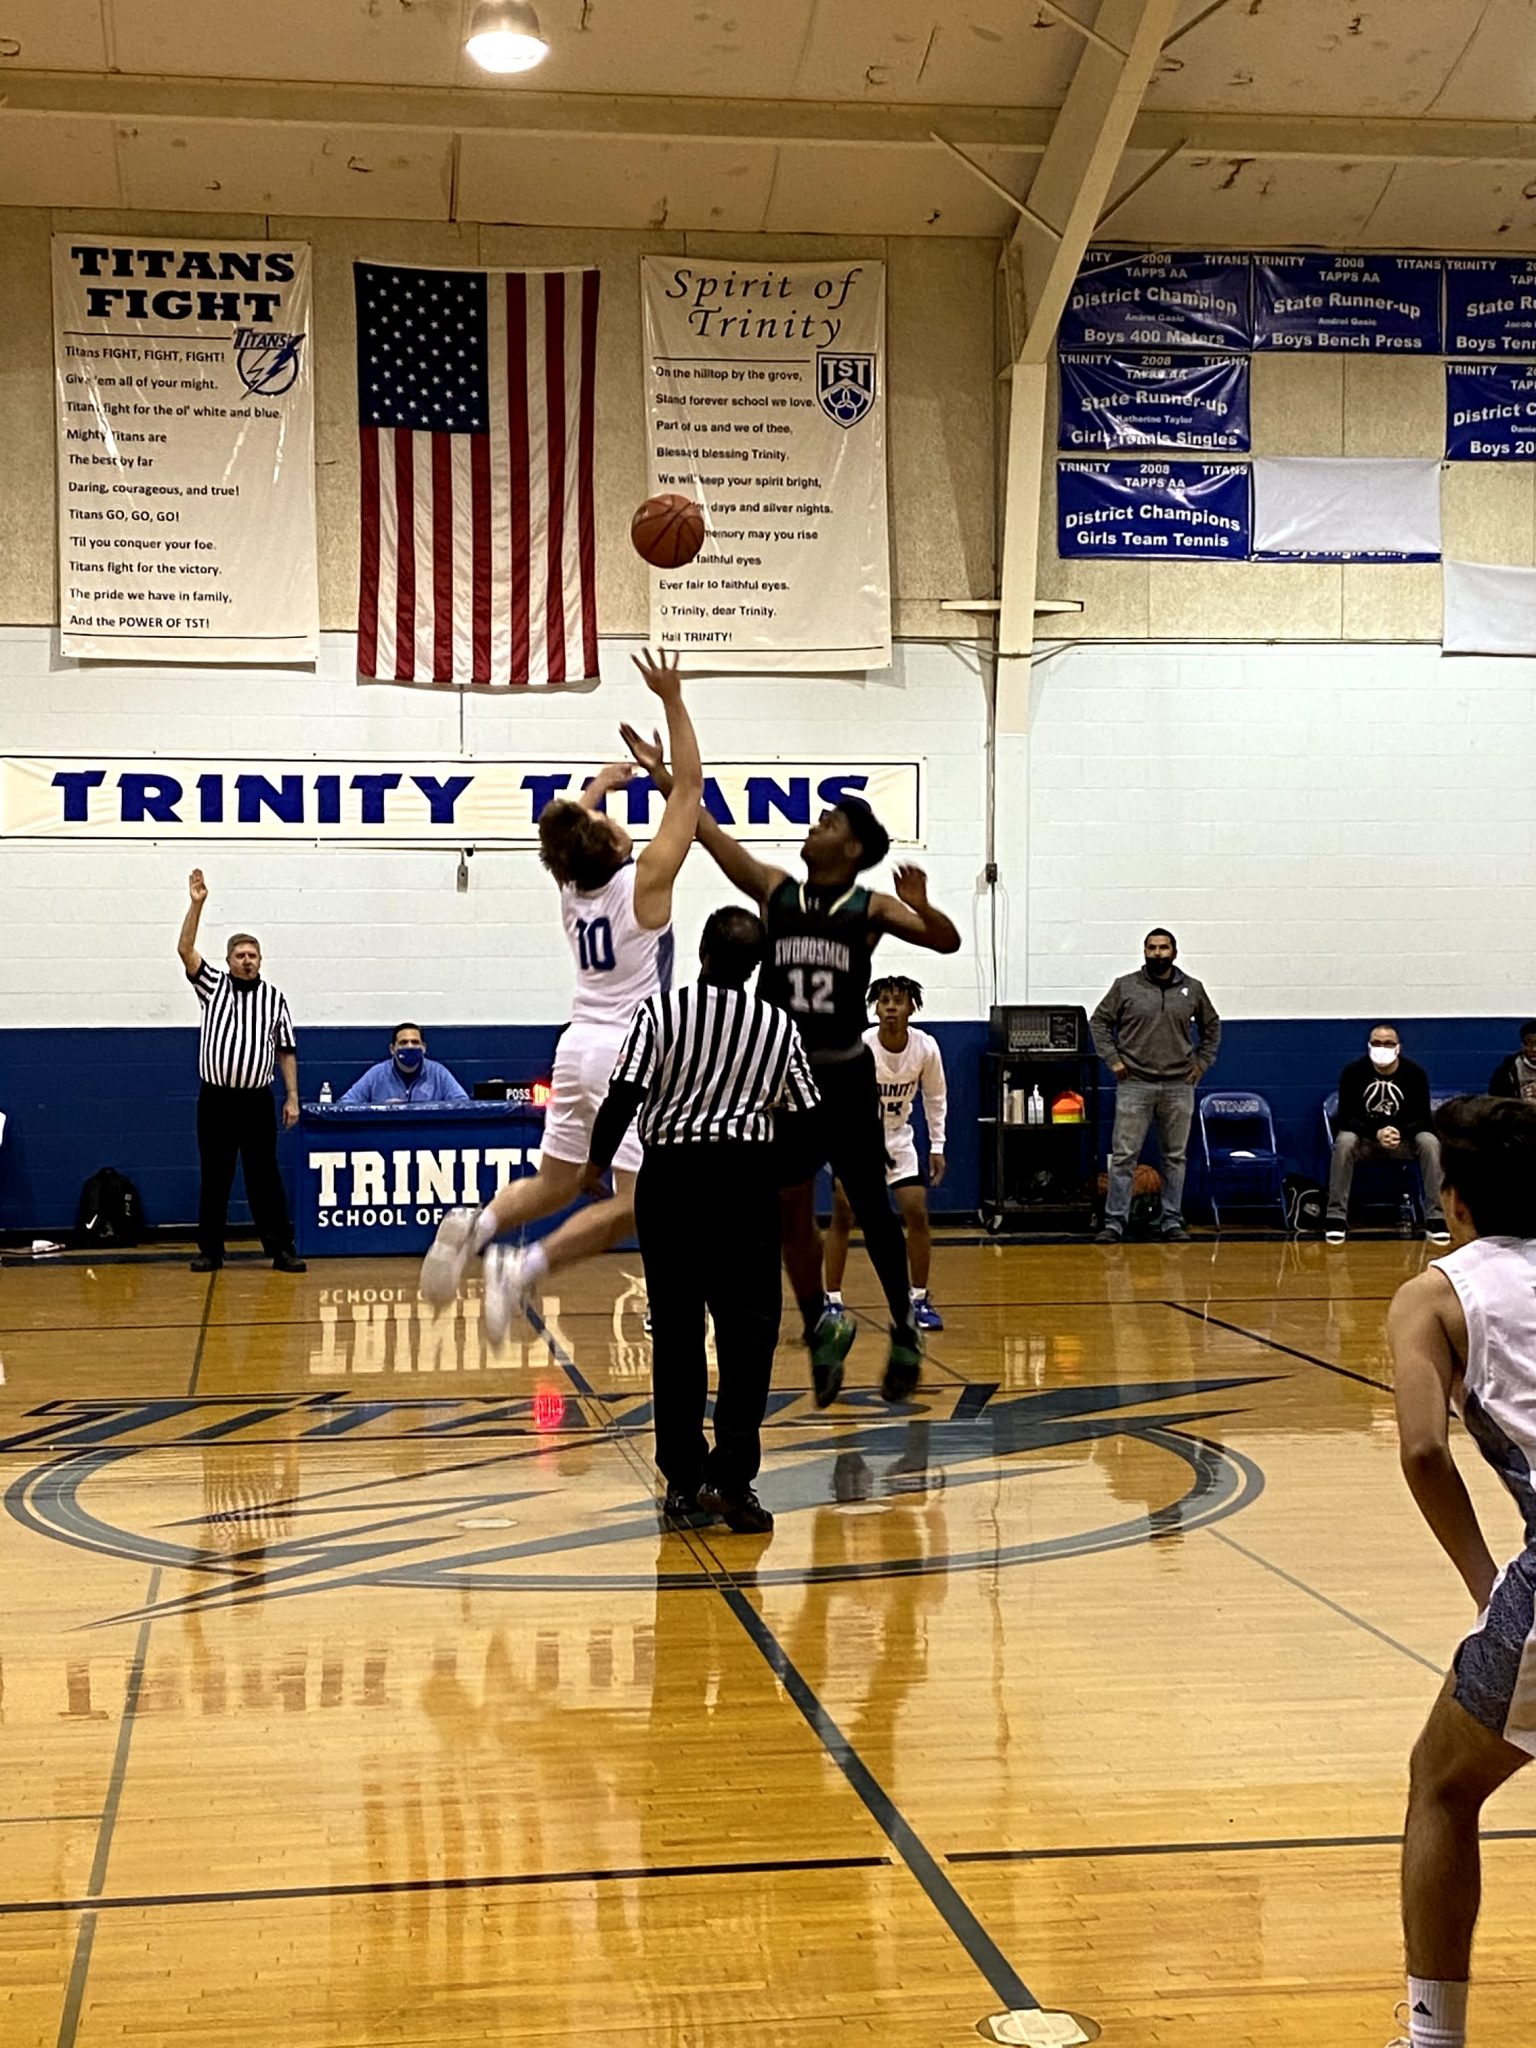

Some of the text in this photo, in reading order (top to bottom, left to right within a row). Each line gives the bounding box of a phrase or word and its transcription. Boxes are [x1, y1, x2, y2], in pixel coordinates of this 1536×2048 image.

[71, 247, 294, 282] TITANS
[1204, 254, 1249, 265] TITANS
[1254, 256, 1441, 269] TRINITY 2008 TITANS
[1446, 261, 1497, 270] TRINITY
[1126, 268, 1187, 278] TAPPS AA
[1319, 271, 1380, 283] TAPPS AA
[665, 268, 863, 310] Spirit of
[87, 288, 281, 322] FIGHT
[1072, 287, 1237, 316] District Champion
[1274, 293, 1420, 319] State Runner-up
[1467, 299, 1514, 317] State
[688, 307, 841, 349] Trinity
[234, 327, 288, 349] TITANS
[1085, 329, 1225, 345] Boys 400 Meters
[1272, 333, 1422, 348] Boys Bench Press
[1456, 336, 1496, 352] Boys
[65, 347, 224, 362] Titans FIGHT, FIGHT, FIGHT!
[1060, 355, 1171, 365] TRINITY 2008
[656, 367, 802, 382] On the hilltop by the grove,
[823, 360, 868, 386] TST
[1447, 365, 1497, 375] TRINITY
[119, 377, 132, 386] all
[136, 377, 148, 386] of
[151, 380, 176, 389] your
[181, 379, 218, 390] might.
[656, 394, 815, 407] Stand forever school we love.
[1081, 391, 1228, 416] State Runner-up
[103, 403, 282, 419] fight for the white and blue.
[1454, 404, 1521, 427] District
[656, 420, 678, 432] Part
[681, 421, 690, 432] of
[694, 423, 707, 432] us
[711, 422, 731, 433] and
[734, 424, 749, 433] we
[753, 422, 763, 433] of
[66, 429, 167, 442] Mighty are
[1176, 432, 1238, 448] Singles
[702, 448, 789, 462] blessing Trinity.
[1470, 441, 1510, 457] Boys
[68, 454, 153, 468] The best by far
[1060, 463, 1247, 475] TRINITY 2008 TITANS
[658, 474, 822, 489] We keep your spirit bright,
[1125, 478, 1186, 488] TAPPS AA
[112, 485, 183, 496] courageous,
[186, 485, 207, 495] and
[211, 485, 239, 496] true!
[69, 509, 179, 522] Titans GO, GO, GO!
[710, 503, 736, 514] days
[740, 503, 760, 513] and
[763, 502, 793, 513] silver
[796, 503, 833, 515] nights.
[1066, 505, 1241, 531] District Champions
[748, 530, 770, 541] may
[774, 531, 794, 541] you
[797, 530, 818, 540] rise
[1077, 531, 1229, 546] Girls Team Tennis
[89, 539, 110, 550] you
[114, 539, 161, 551] conquer
[165, 540, 190, 551] your
[697, 554, 733, 565] faithful
[736, 556, 761, 566] eyes
[69, 560, 222, 576] Titans fight for the victory.
[659, 580, 789, 592] Ever fair to faithful eyes.
[70, 588, 232, 603] The pride we have in family,
[672, 605, 776, 618] Trinity, dear Trinity.
[70, 615, 209, 628] And the POWER OF TST!
[684, 632, 732, 642] TRINITY!
[51, 770, 475, 824] TRINITY
[575, 916, 616, 972] 10
[788, 968, 835, 1014] 12
[318, 1209, 406, 1227] SCHOOL
[416, 1208, 443, 1225] OF
